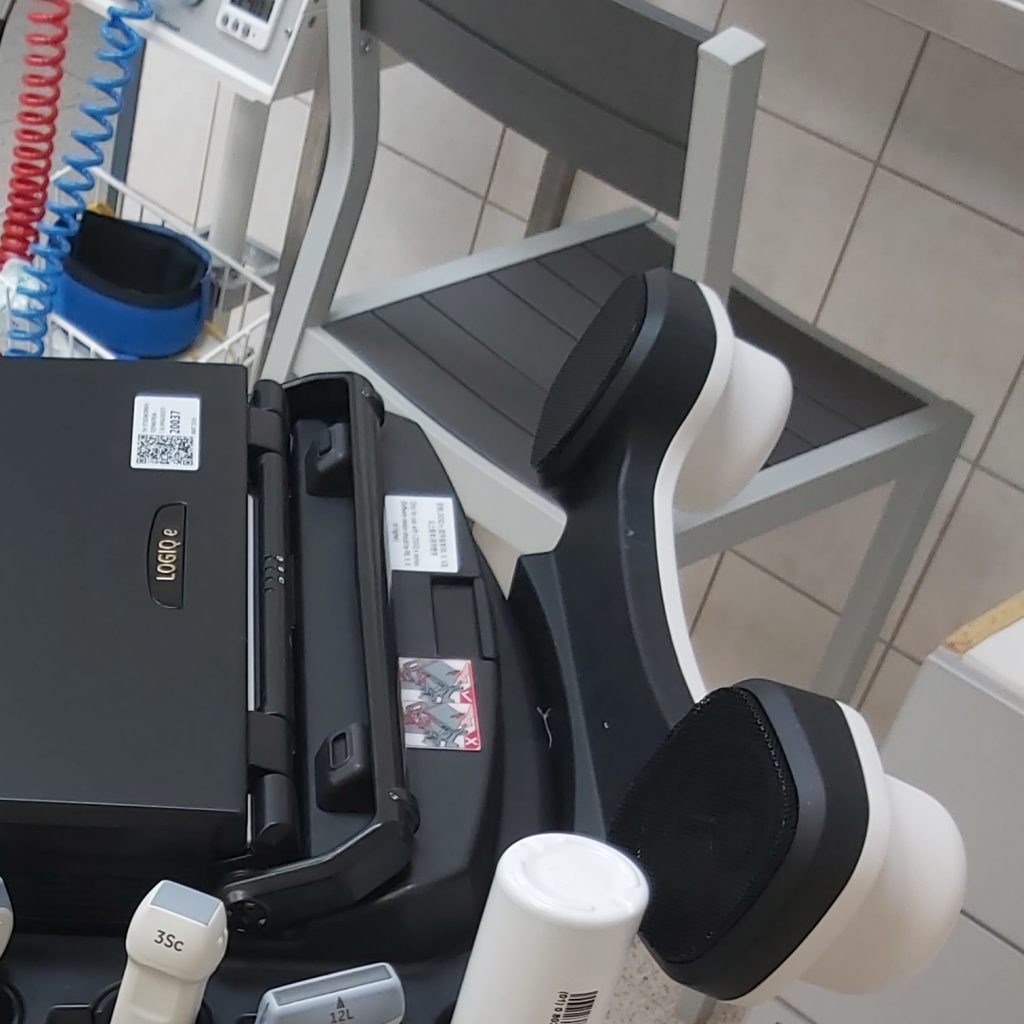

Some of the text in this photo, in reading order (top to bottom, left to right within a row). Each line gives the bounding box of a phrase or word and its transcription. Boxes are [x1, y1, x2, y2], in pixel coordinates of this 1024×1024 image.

[169, 410, 181, 434] 20037
[155, 528, 182, 581] LOGIQ e
[153, 929, 185, 952] 3Sc
[554, 991, 569, 1006] (01)
[329, 1009, 355, 1024] 12L
